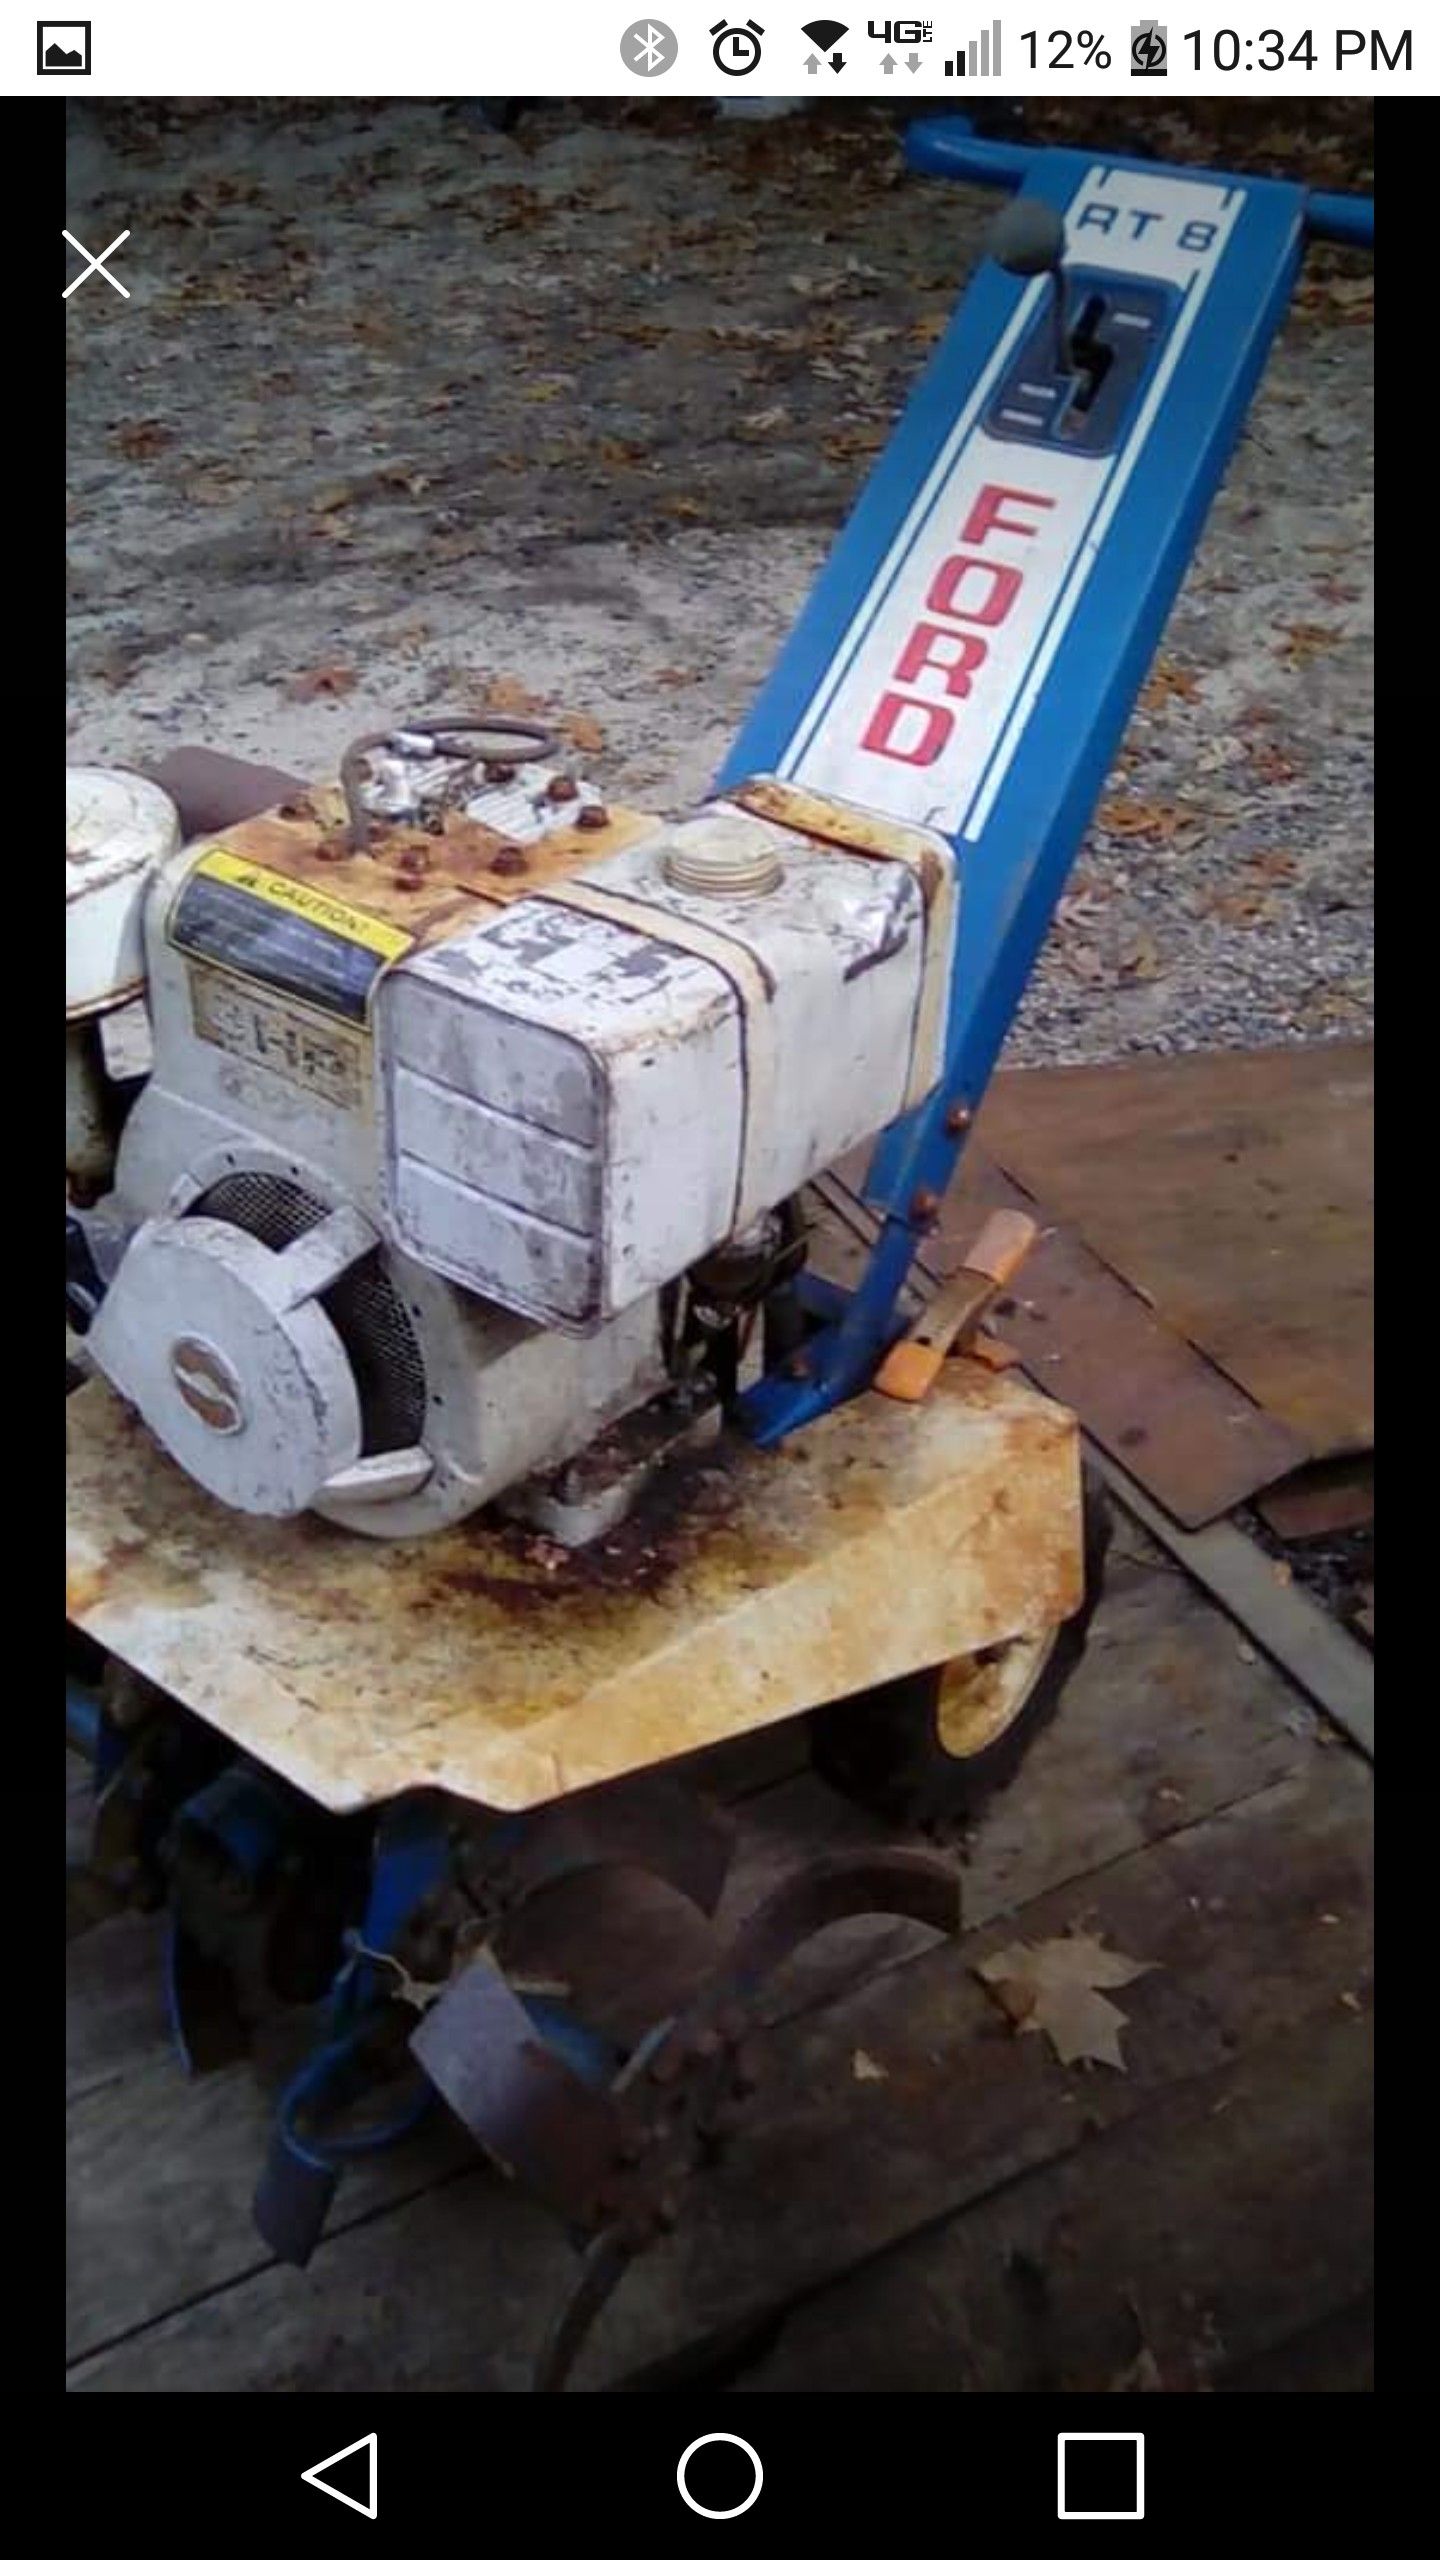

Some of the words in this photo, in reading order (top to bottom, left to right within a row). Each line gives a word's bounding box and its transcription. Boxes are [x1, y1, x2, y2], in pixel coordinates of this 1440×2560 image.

[1077, 202, 1164, 241] RT
[1176, 220, 1220, 252] 8
[859, 484, 1056, 767] FORD
